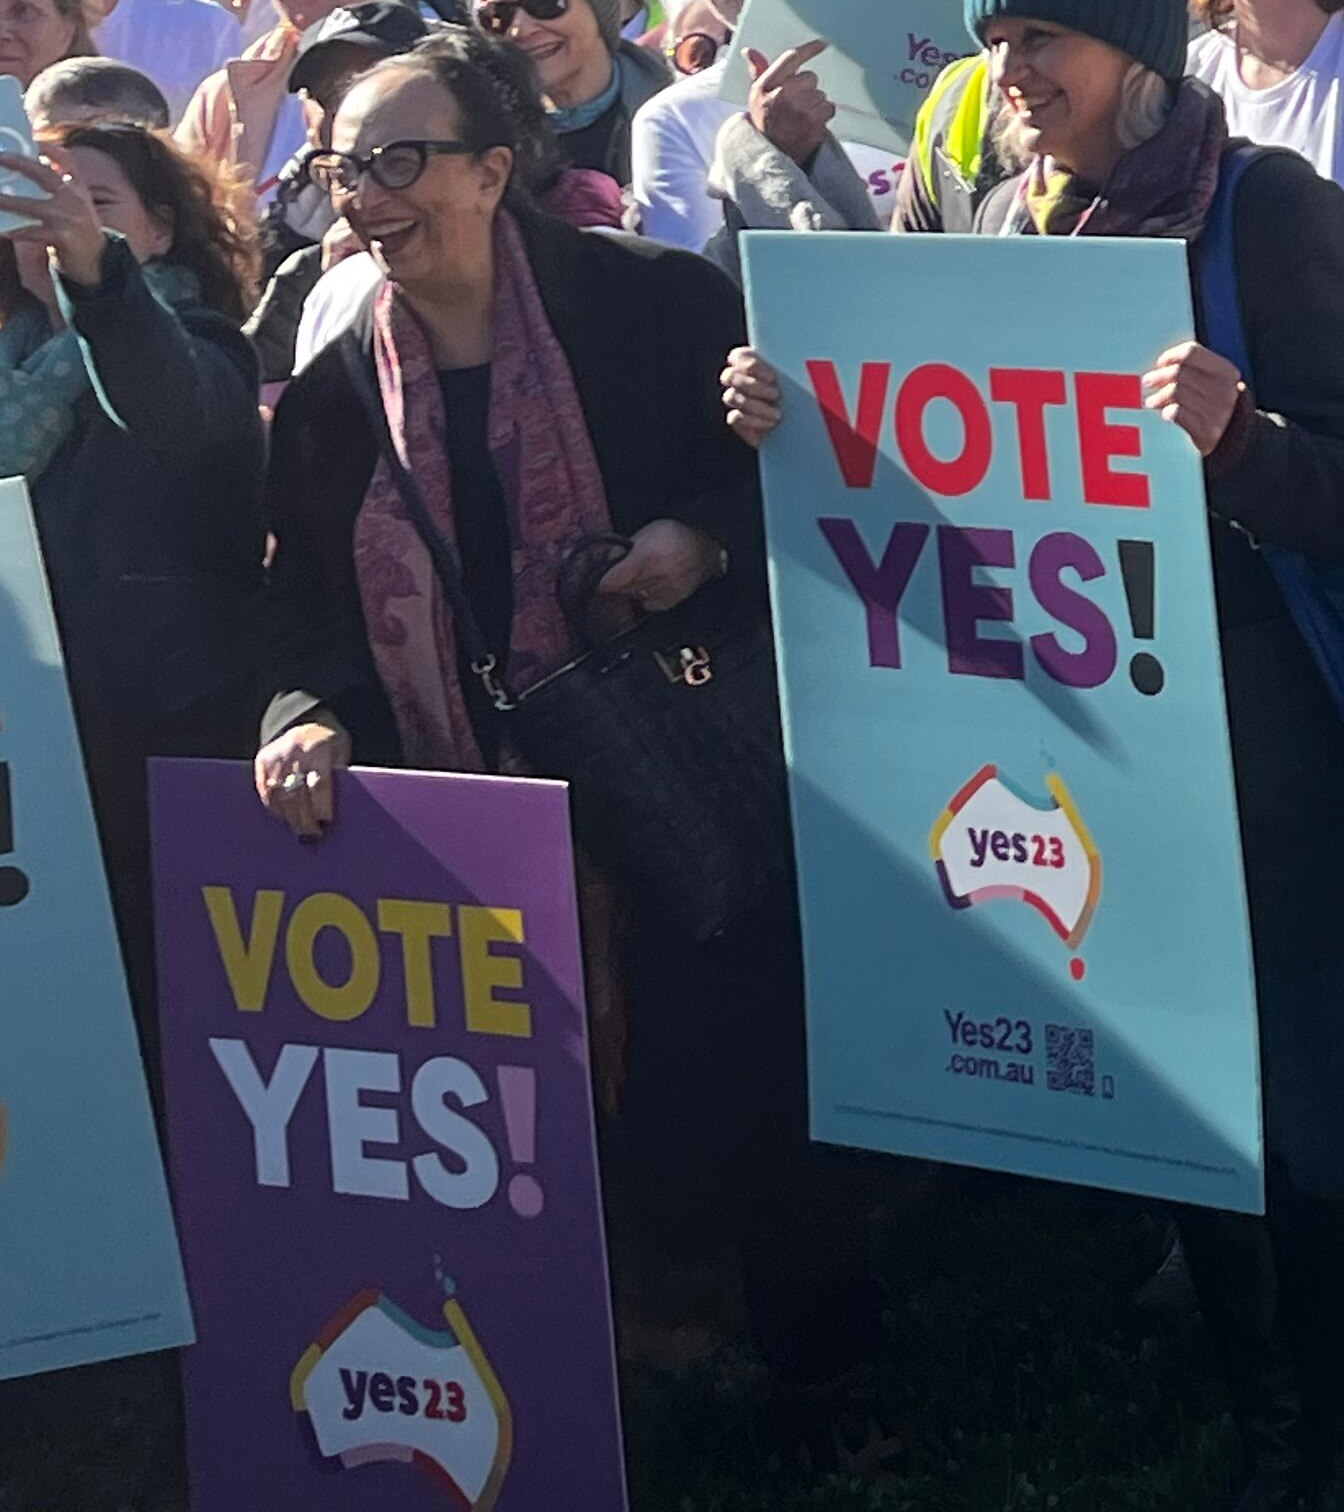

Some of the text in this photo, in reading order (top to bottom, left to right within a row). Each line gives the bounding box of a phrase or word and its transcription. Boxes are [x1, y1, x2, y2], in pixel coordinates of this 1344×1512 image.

[806, 360, 1151, 508] VOTE
[818, 516, 1165, 696] YES!
[967, 823, 1065, 870] yes23
[203, 886, 534, 1036] VOTE
[944, 1008, 1033, 1054] Yes23
[945, 1053, 1034, 1085] .com.au
[209, 1037, 545, 1218] YES!
[339, 1366, 467, 1422] yes23
